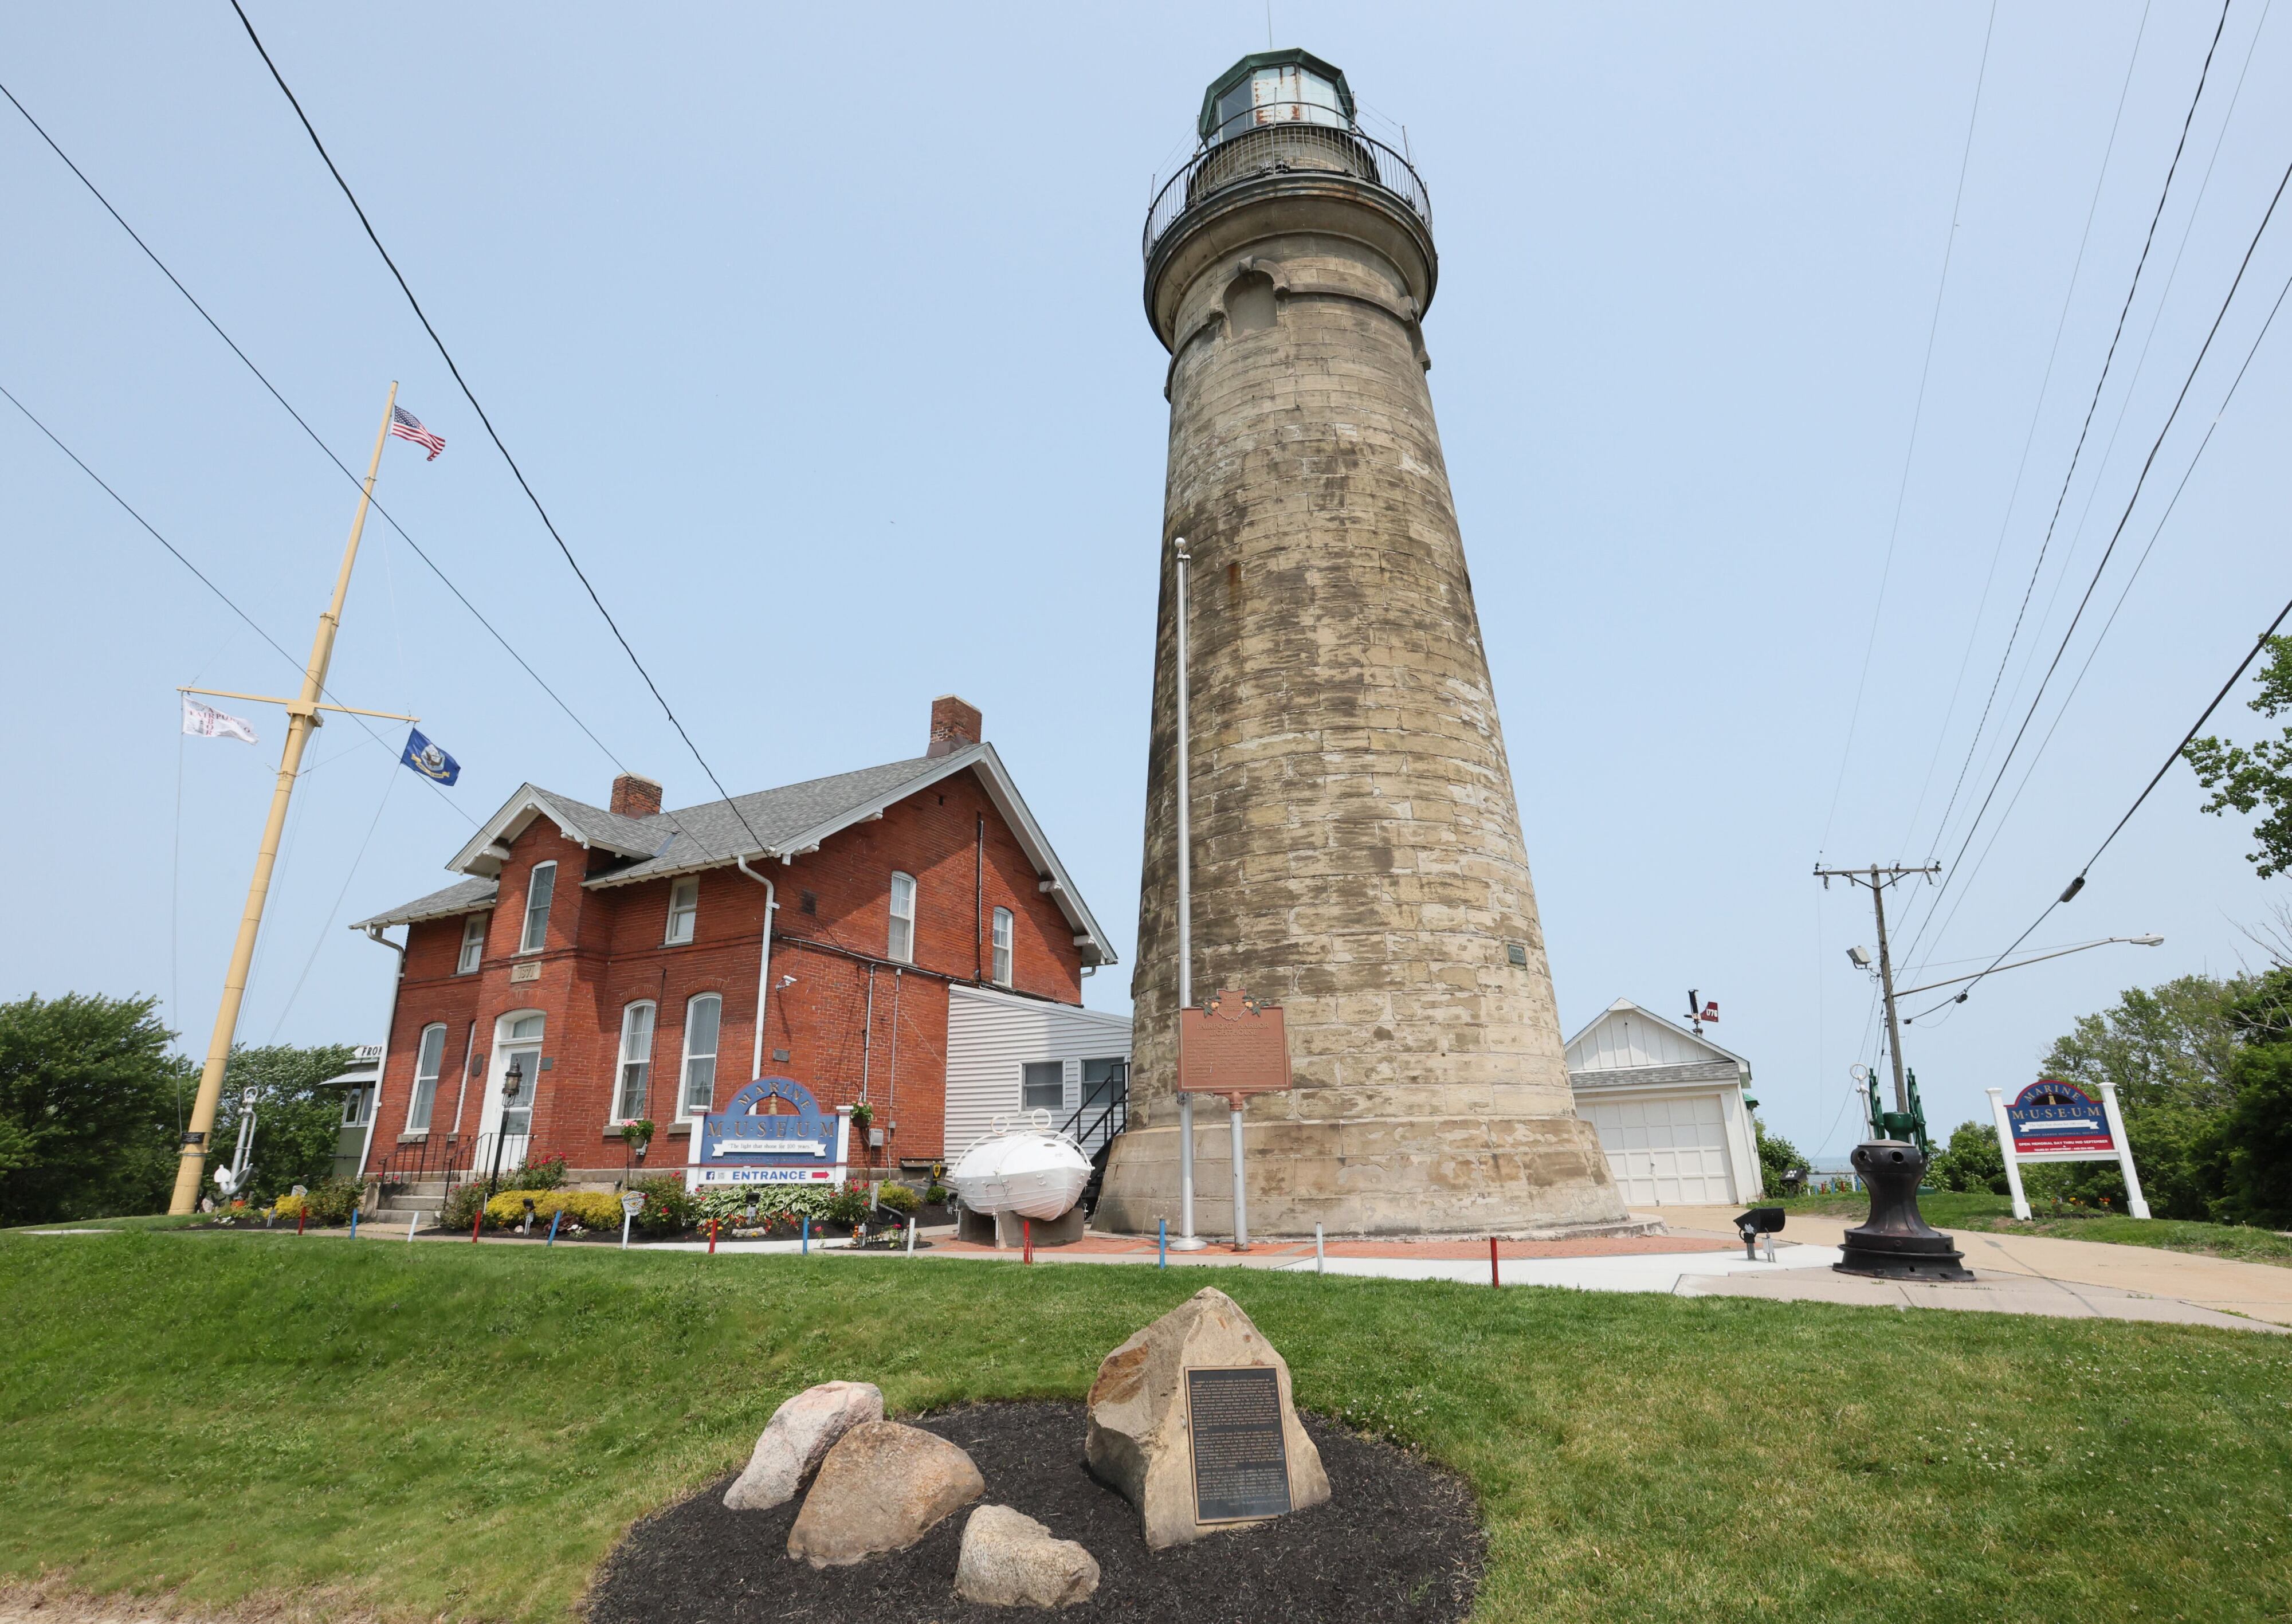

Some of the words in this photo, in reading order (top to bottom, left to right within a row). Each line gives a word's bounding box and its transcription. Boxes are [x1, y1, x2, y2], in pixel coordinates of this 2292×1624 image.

[1706, 1009, 1717, 1017] 1776
[737, 1081, 811, 1111] MARINE
[2024, 1084, 2081, 1102] MARINE
[732, 1171, 806, 1180] ENTRANCE
